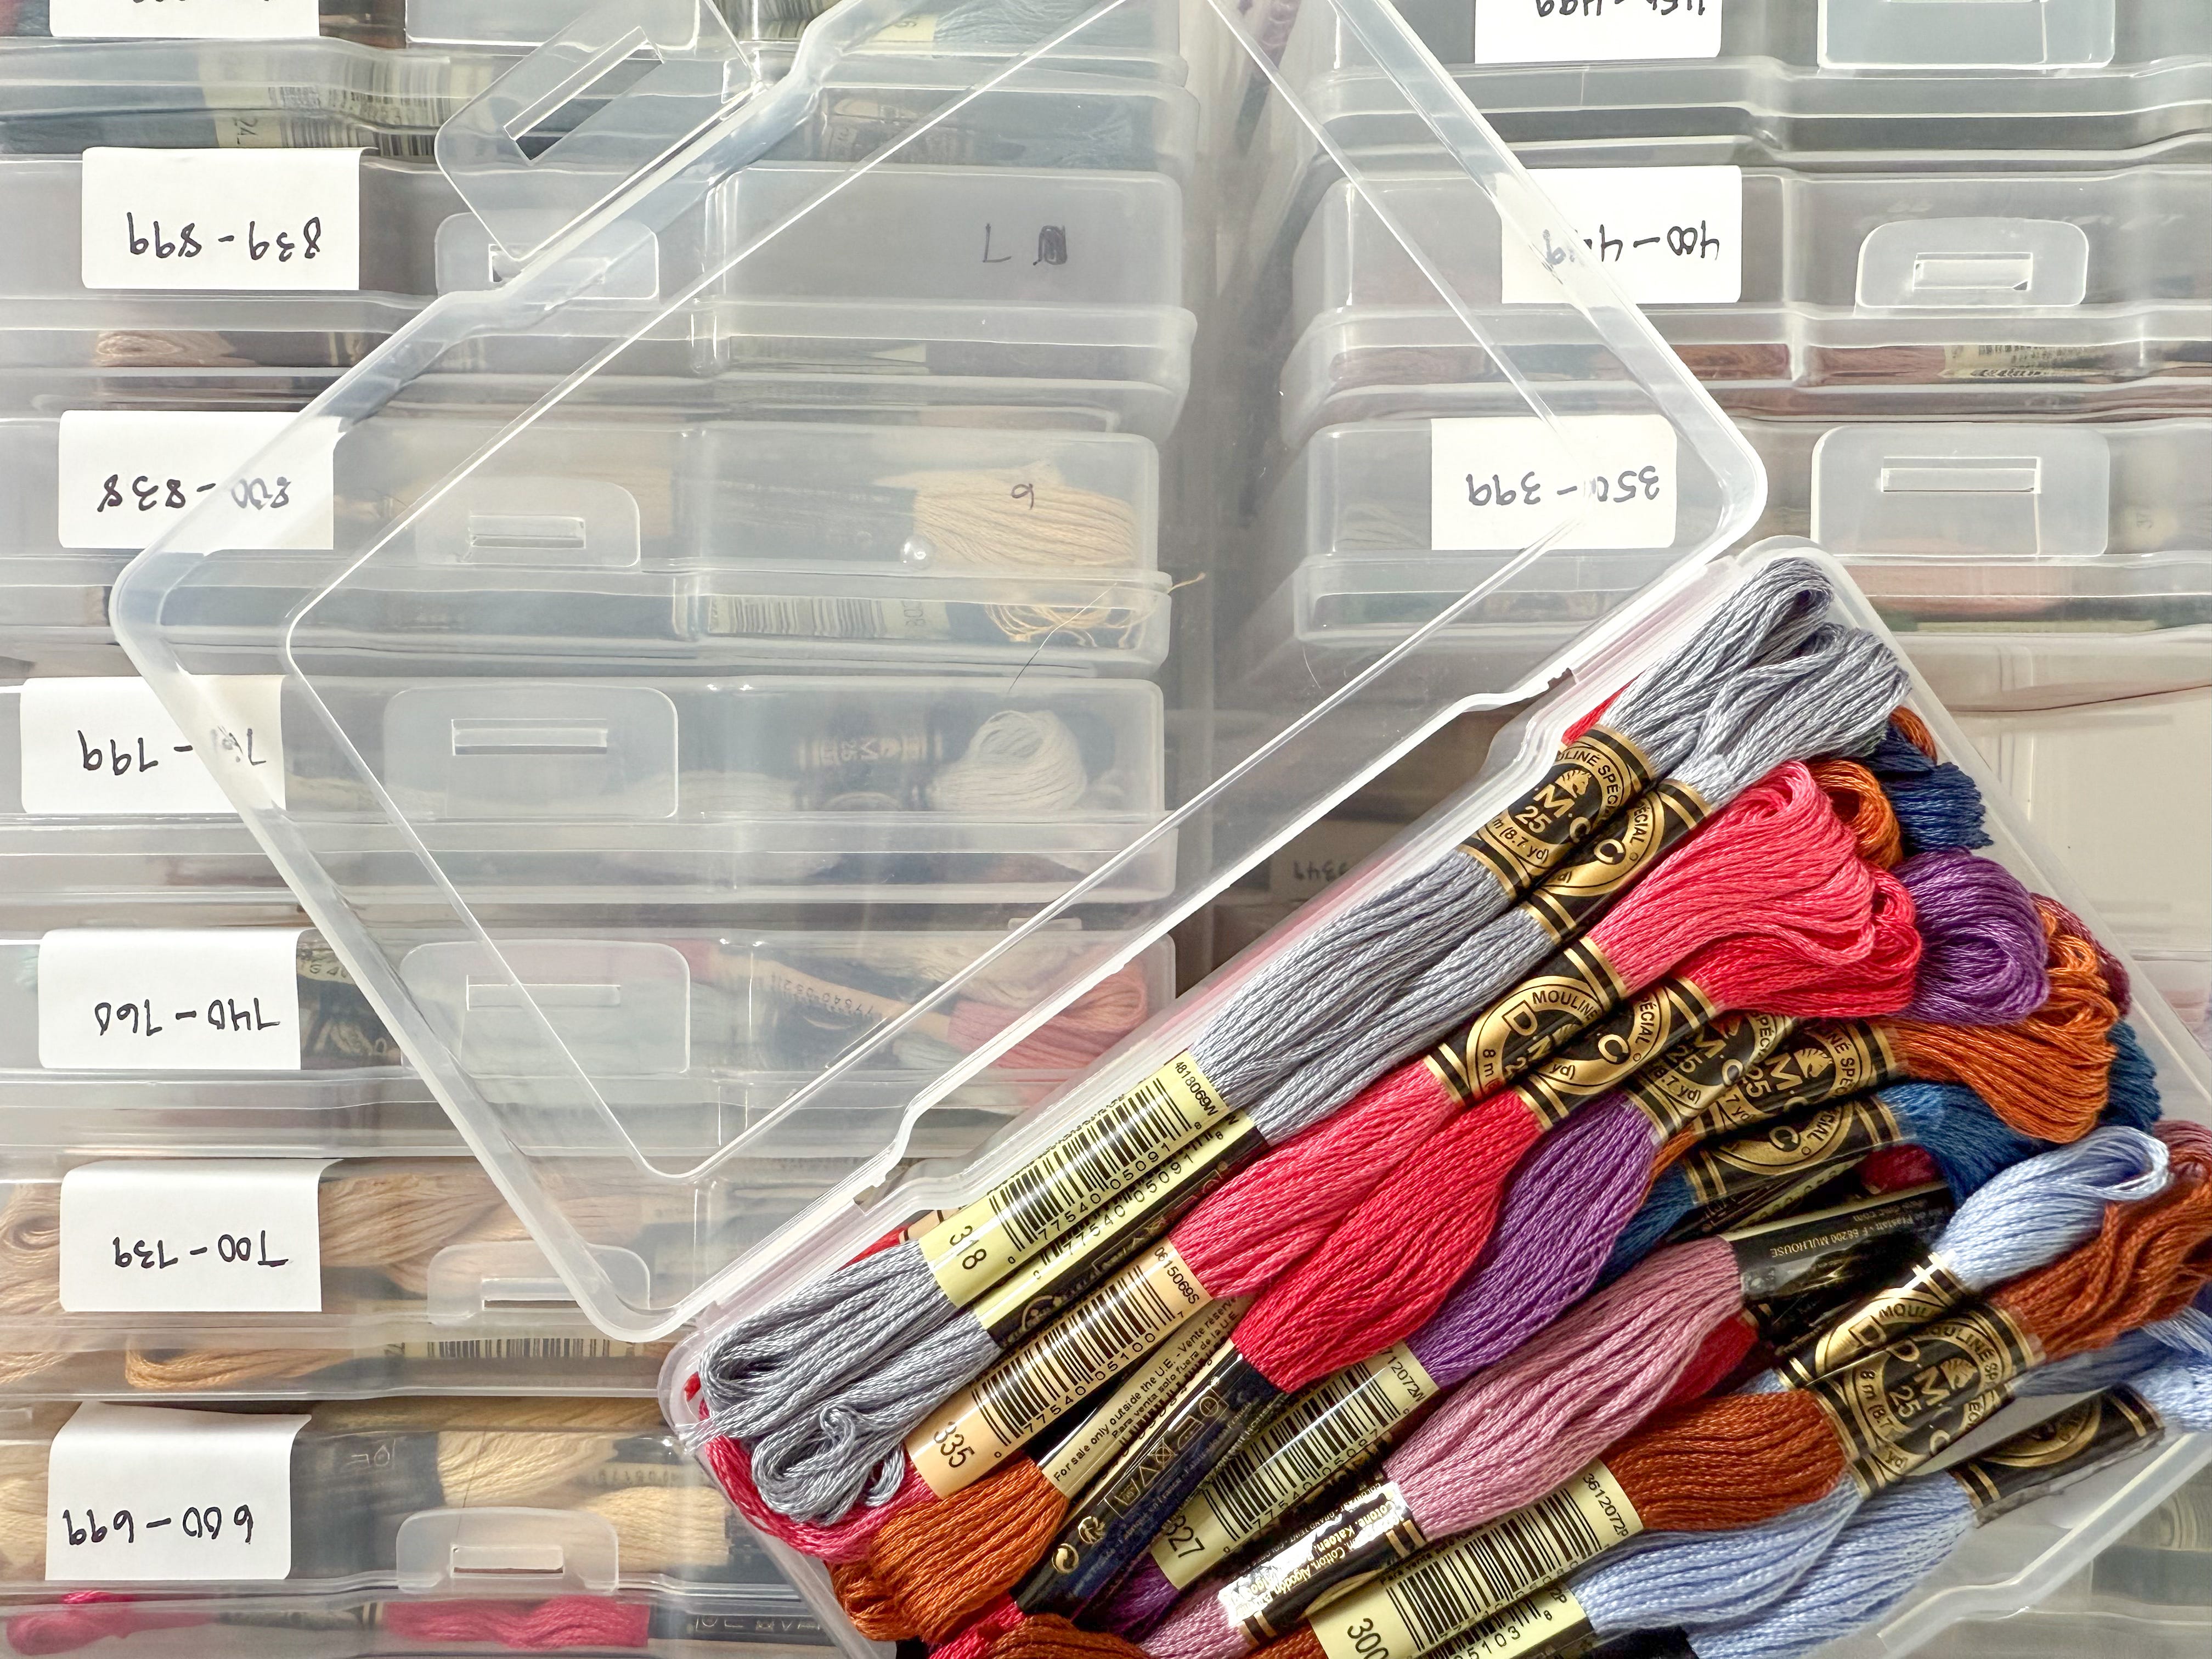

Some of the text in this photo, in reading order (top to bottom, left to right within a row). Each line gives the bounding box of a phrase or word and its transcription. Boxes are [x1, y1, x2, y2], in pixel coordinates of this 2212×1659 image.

[1542, 221, 1720, 267] 400-49
[77, 726, 267, 776] 7-799
[1515, 805, 1551, 833] 25
[1038, 1190, 1102, 1243] 77540
[1108, 1140, 1171, 1192] 05091
[1132, 1153, 1194, 1203] 05091
[1769, 1235, 1829, 1258] MULHOUSE
[1023, 1384, 1088, 1435] 77540
[1092, 1331, 1158, 1382] 05100
[1087, 1423, 1112, 1447] only
[1107, 1389, 1143, 1426] outside
[1138, 1373, 1158, 1393] the
[1177, 1324, 1206, 1354] Vente
[1132, 1391, 1158, 1418] venta
[1889, 1385, 1922, 1418] 25
[934, 1421, 975, 1468] 335
[1543, 1610, 1553, 1621] 8
